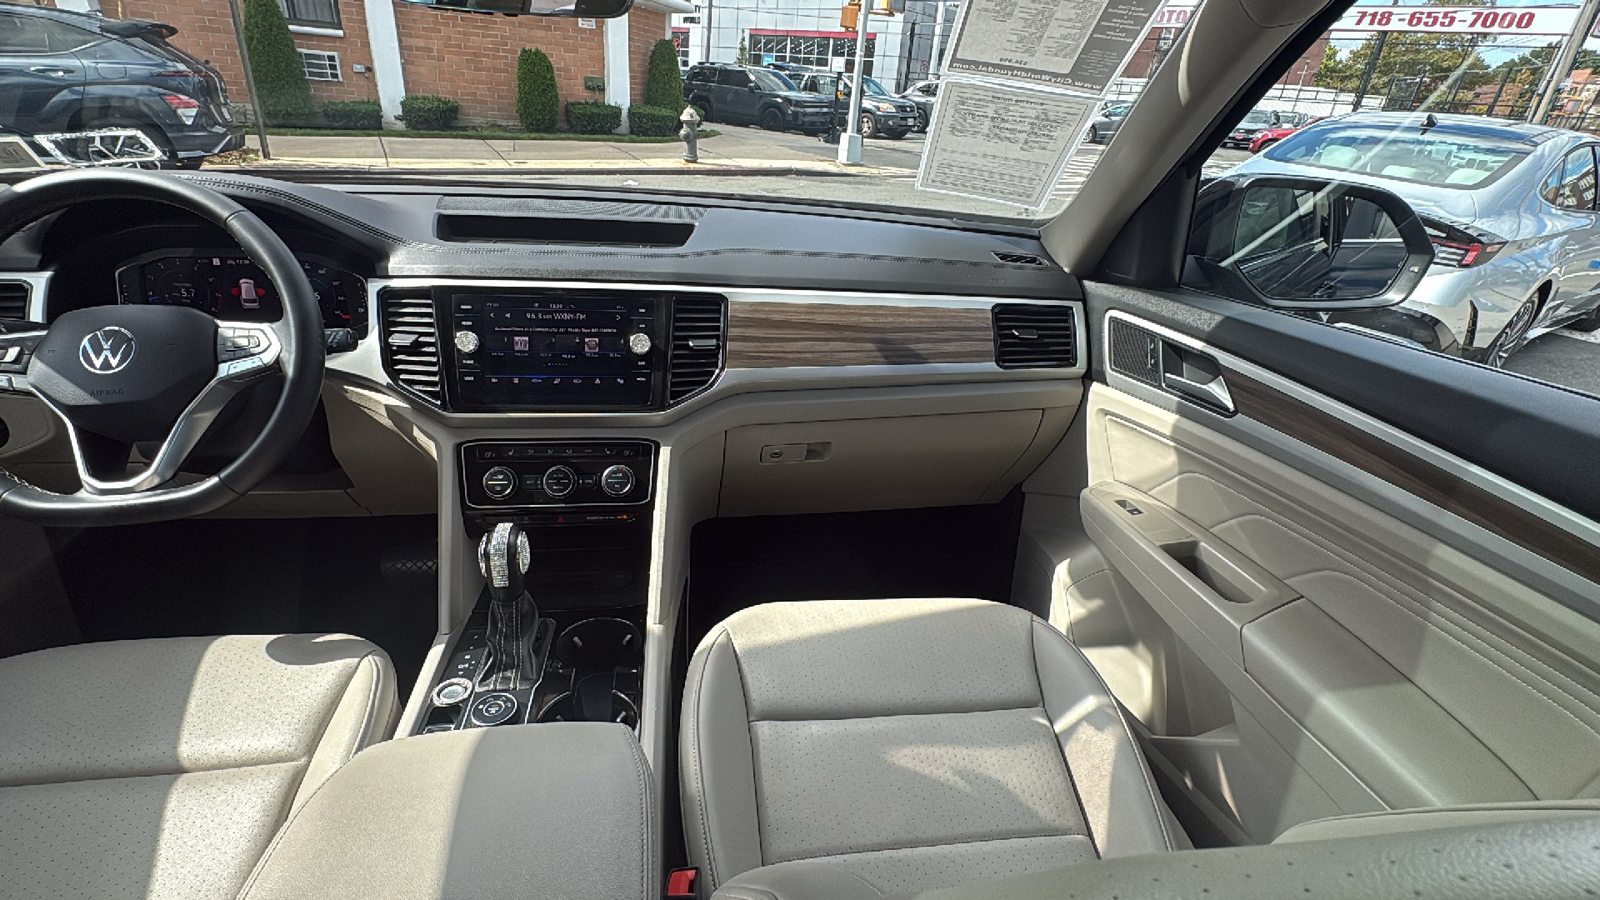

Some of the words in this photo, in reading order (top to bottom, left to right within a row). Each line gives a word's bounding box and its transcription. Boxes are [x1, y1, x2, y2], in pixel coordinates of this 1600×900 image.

[683, 16, 701, 24] WORLD
[1354, 10, 1536, 30] 718-655-7000
[181, 288, 196, 298] 5.7
[89, 388, 124, 397] AIRBAG
